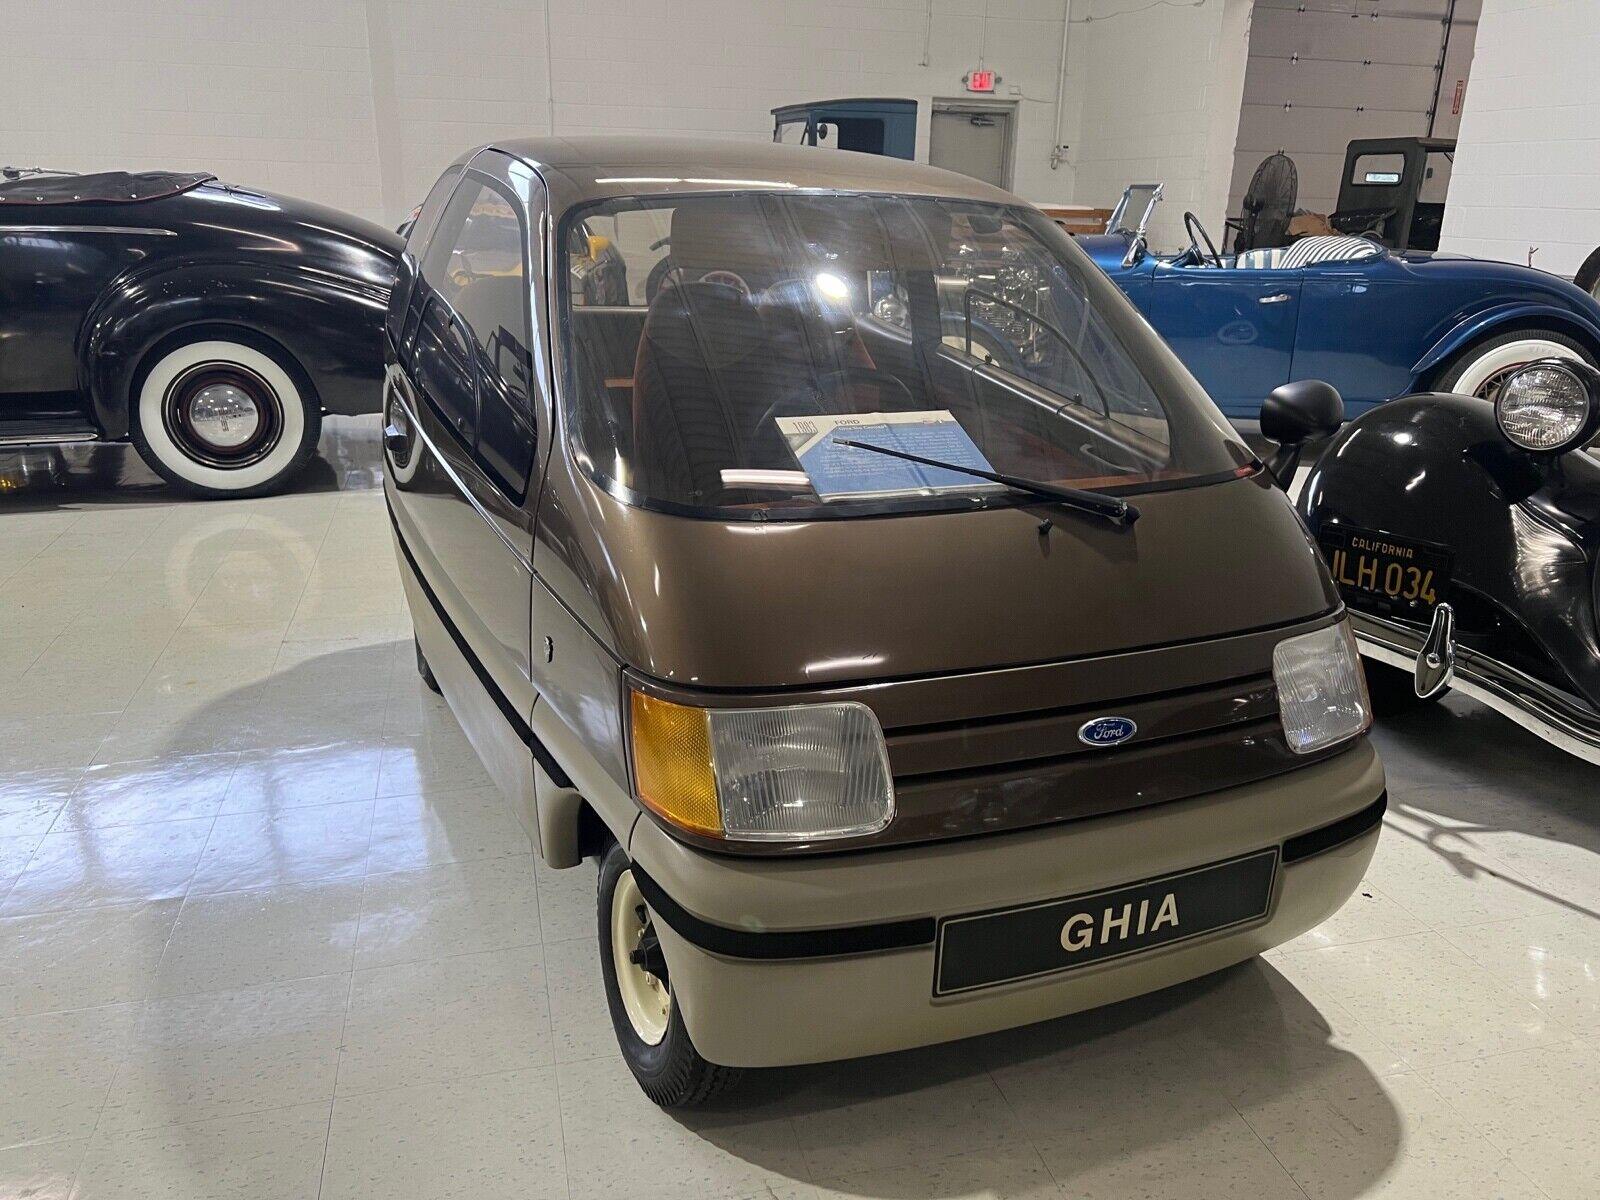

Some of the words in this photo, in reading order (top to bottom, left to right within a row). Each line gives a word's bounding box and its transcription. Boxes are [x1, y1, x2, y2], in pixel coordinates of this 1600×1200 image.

[1351, 536, 1413, 559] CALIFORNIA
[1384, 562, 1436, 605] 034
[1093, 722, 1125, 740] Ford
[1060, 893, 1180, 952] GHIA
